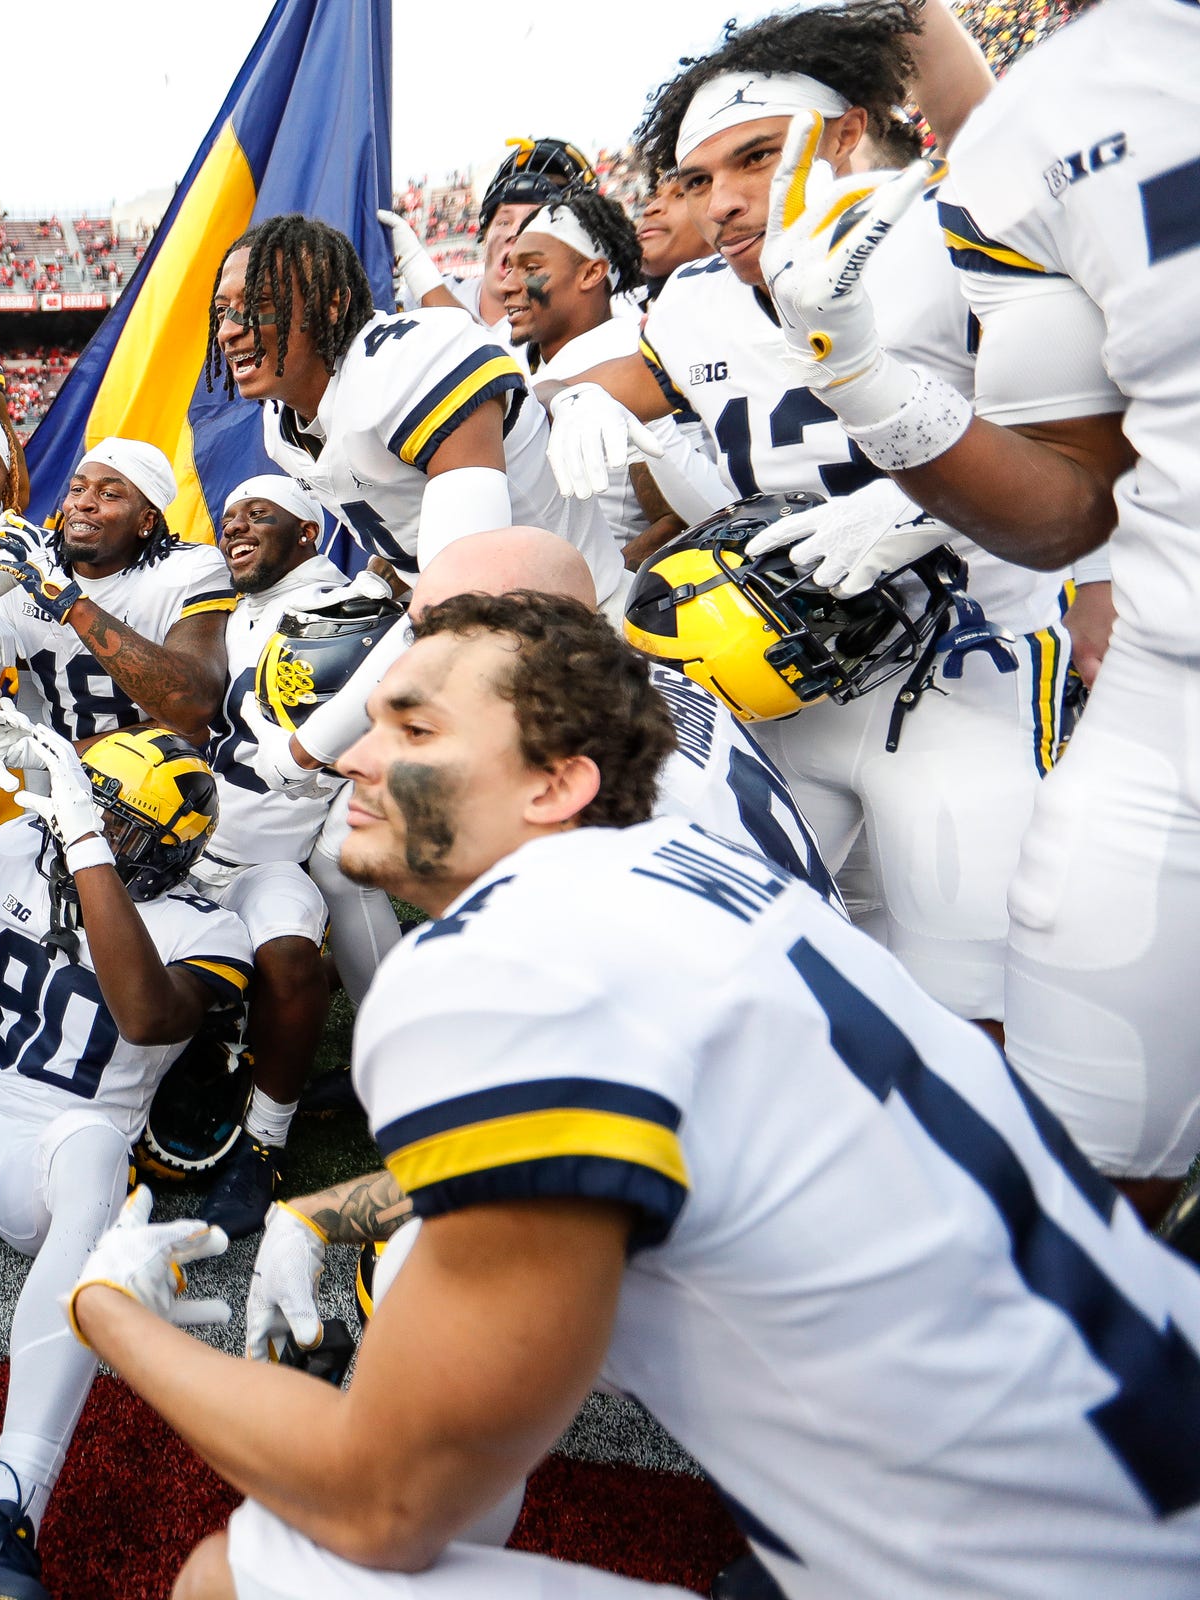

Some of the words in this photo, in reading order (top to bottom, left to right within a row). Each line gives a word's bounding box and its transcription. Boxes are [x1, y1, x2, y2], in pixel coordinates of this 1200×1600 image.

[831, 219, 892, 299] MICHIGAN
[63, 295, 102, 308] GRIFFIN
[779, 663, 803, 685] M
[29, 648, 148, 742] 18
[91, 772, 105, 787] M
[127, 795, 158, 813] JORDAN
